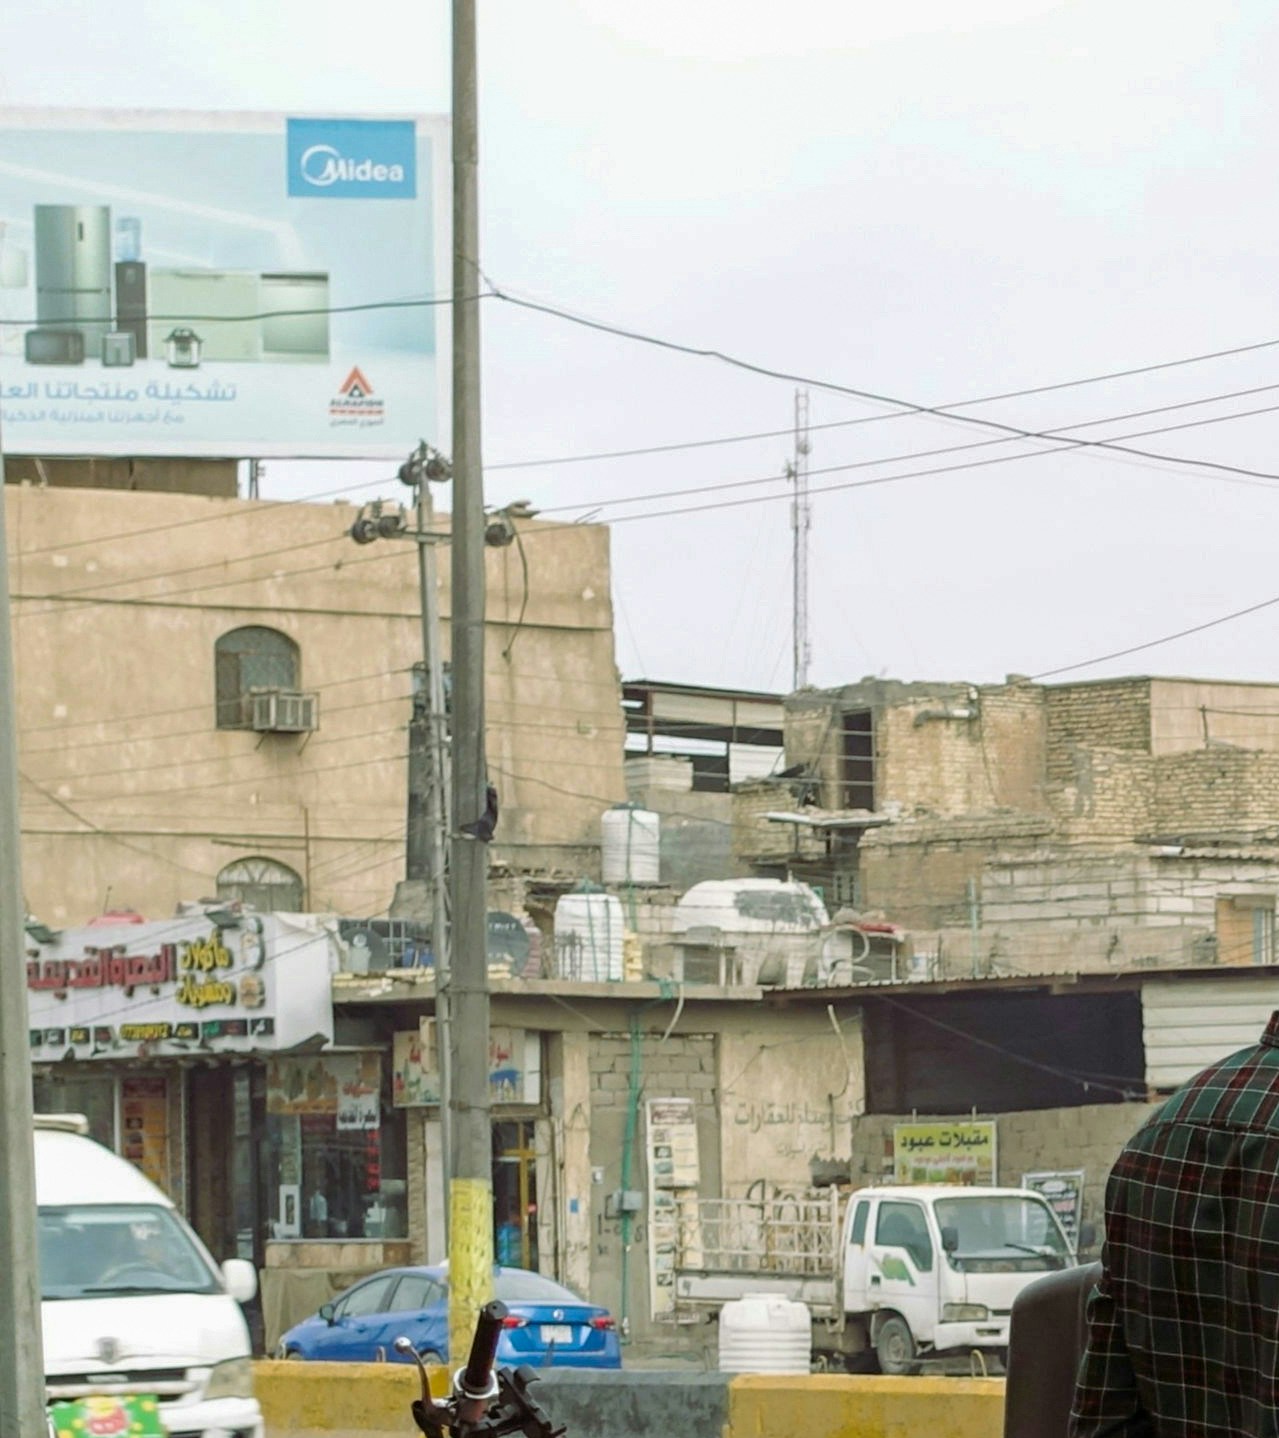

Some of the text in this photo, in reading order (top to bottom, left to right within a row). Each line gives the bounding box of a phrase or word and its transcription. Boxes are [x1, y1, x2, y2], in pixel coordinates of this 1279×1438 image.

[305, 149, 404, 184] Midea
[0, 380, 238, 405] تشكيلة منتجاتنا الع
[900, 1128, 989, 1152] مقبلات عبود
